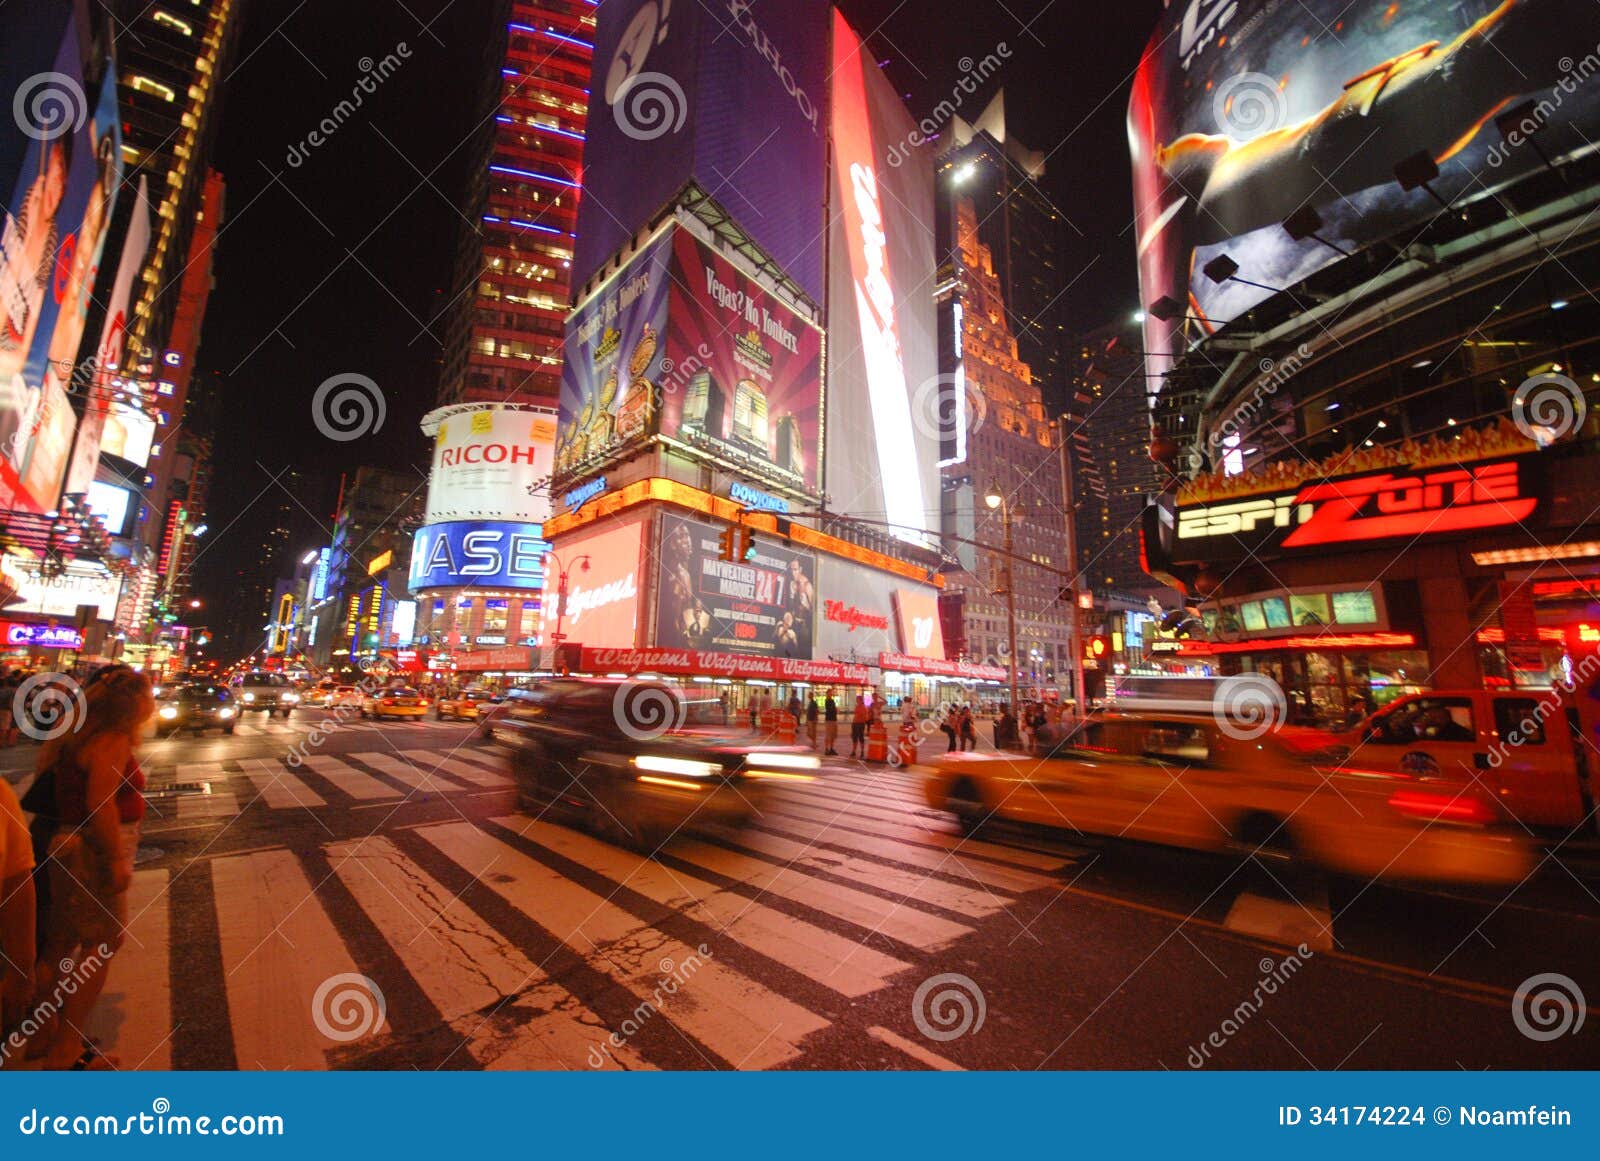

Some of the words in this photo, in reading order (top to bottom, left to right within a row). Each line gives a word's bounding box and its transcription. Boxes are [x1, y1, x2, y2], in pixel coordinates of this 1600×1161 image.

[440, 443, 535, 469] RICOH
[592, 649, 691, 671] Walgreens
[696, 652, 773, 676] Walgreens
[781, 659, 840, 681] Walgreens
